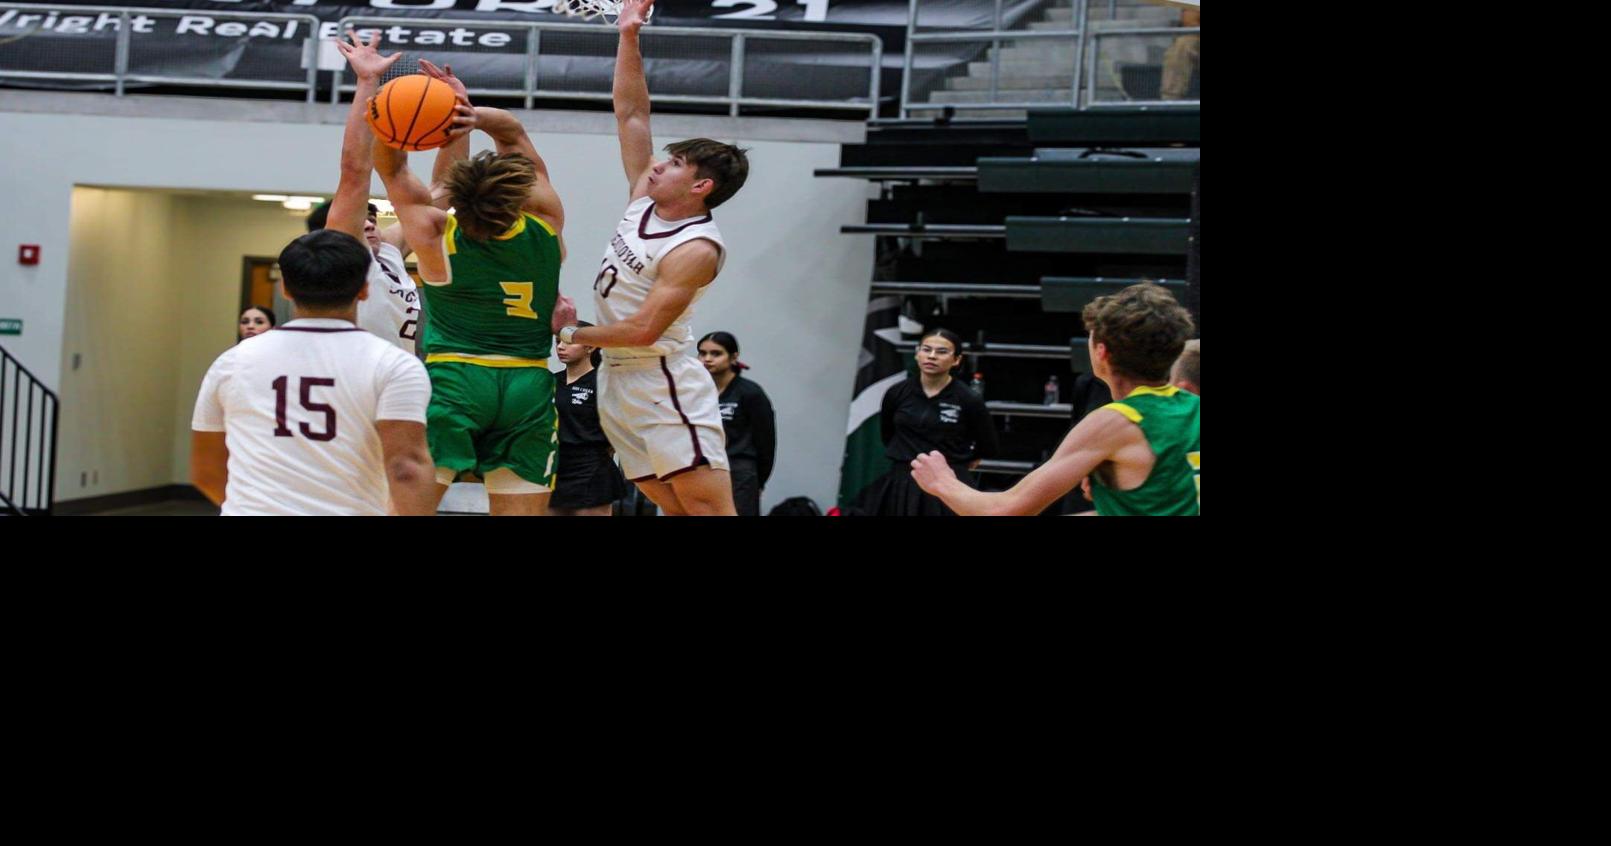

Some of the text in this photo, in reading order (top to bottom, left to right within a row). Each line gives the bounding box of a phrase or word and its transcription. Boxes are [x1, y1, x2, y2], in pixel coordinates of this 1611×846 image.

[175, 16, 299, 39] Real
[319, 21, 511, 47] Estate
[499, 281, 538, 319] 3
[272, 375, 337, 442] 15
